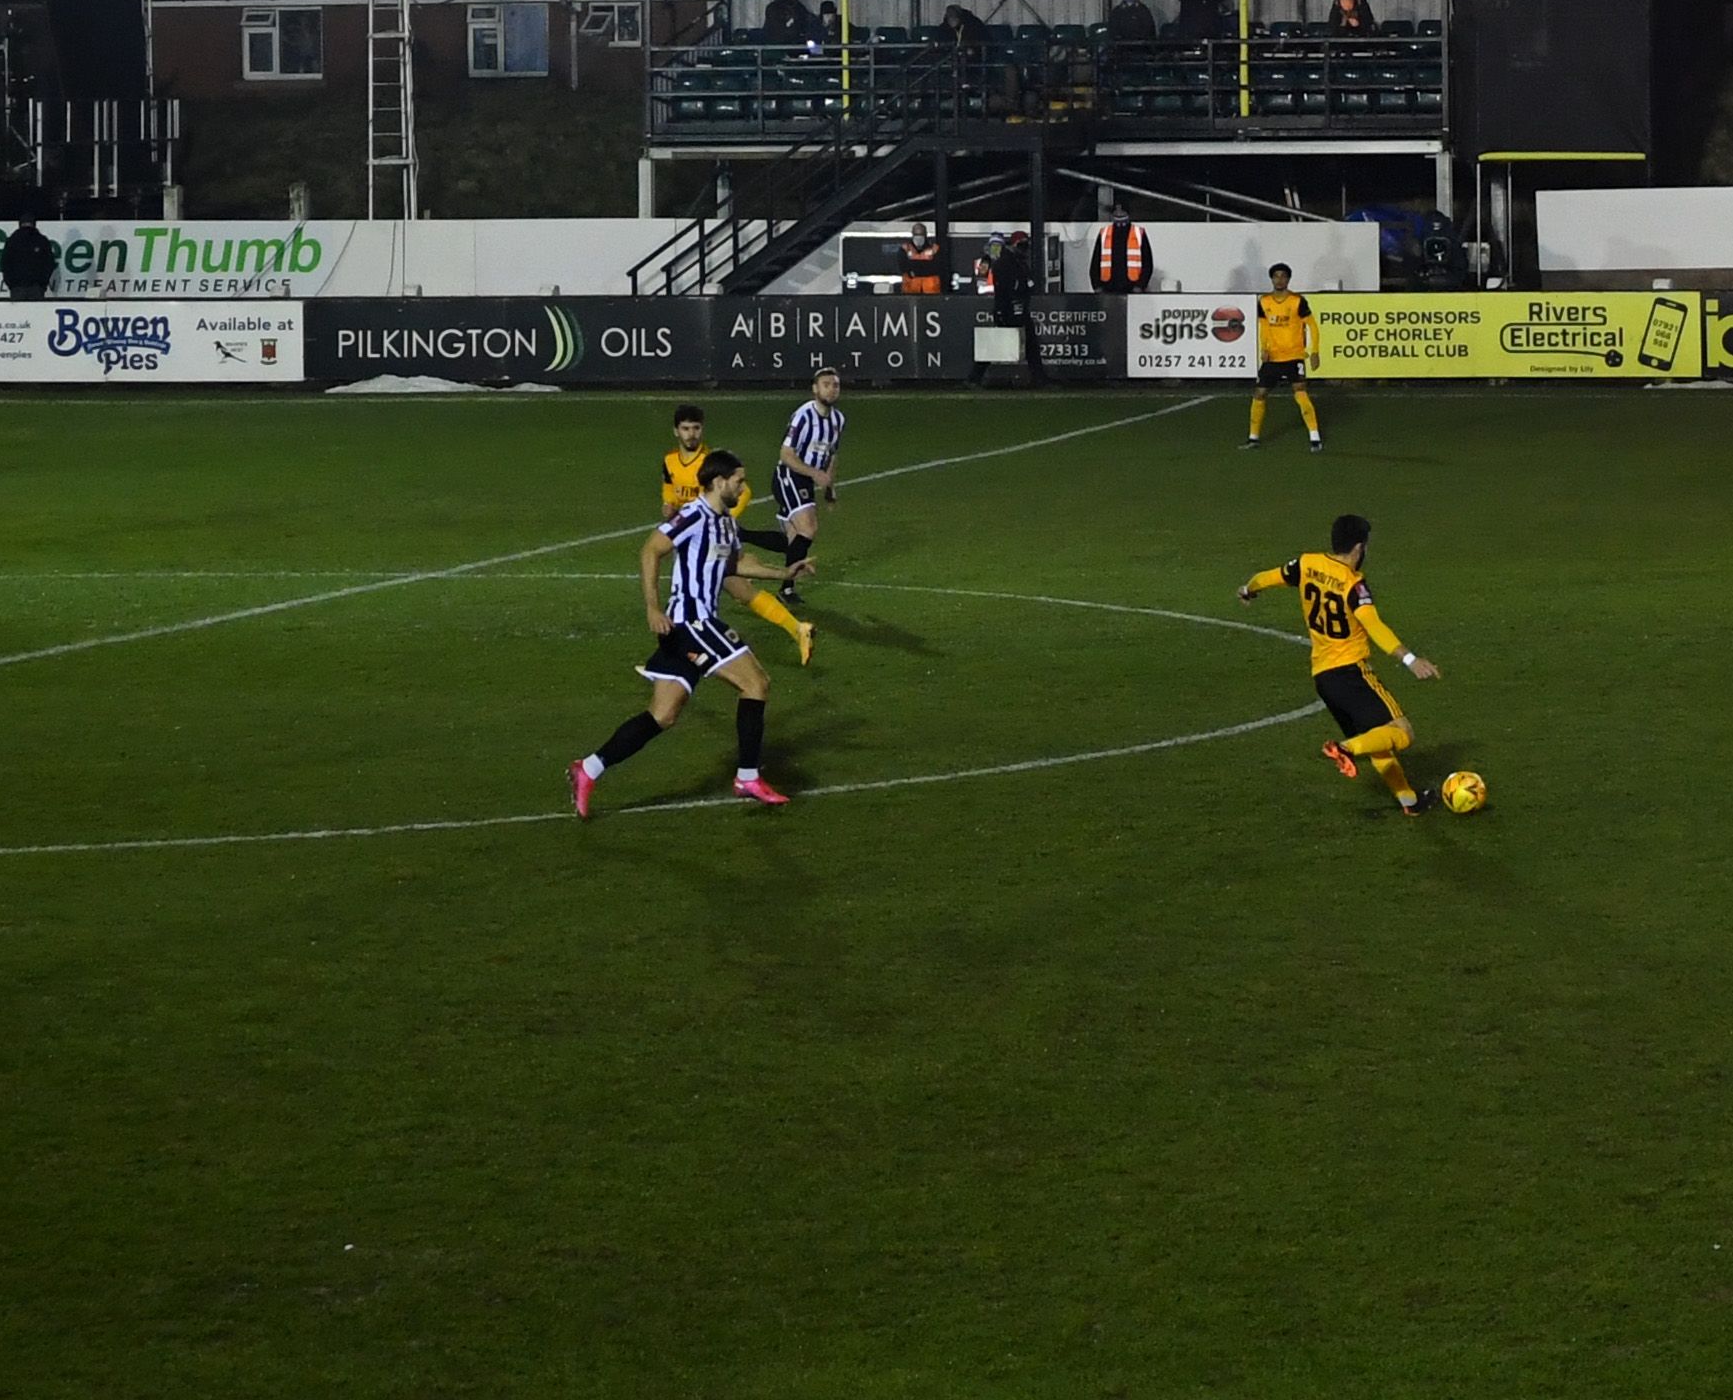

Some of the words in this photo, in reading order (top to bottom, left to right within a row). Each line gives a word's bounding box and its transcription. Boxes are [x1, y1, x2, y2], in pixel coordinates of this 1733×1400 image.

[0, 279, 56, 293] LN
[65, 279, 192, 293] TREATMENT
[1048, 310, 1107, 322] CERTIFIED
[1161, 308, 1209, 328] poppy
[1320, 312, 1379, 326] PROUD
[1385, 311, 1481, 326] SPONSORS
[1528, 302, 1608, 324] Rivers
[196, 317, 271, 332] Available
[277, 318, 294, 332] at
[1034, 324, 1087, 336] UNTANTS
[1140, 319, 1209, 345] signs
[0, 332, 24, 343] 427
[48, 309, 170, 357] Bowen
[1345, 328, 1371, 342] OF
[1374, 327, 1455, 342] CHORLEY
[1510, 327, 1624, 348] Electrical
[337, 328, 537, 359] PILKINGTON
[600, 327, 672, 358] OILS
[1039, 344, 1089, 356] 273313
[730, 351, 942, 368] ASHTON
[1332, 345, 1419, 359] FOOTBALL
[1424, 345, 1469, 358] CLUB
[97, 346, 158, 375] Pies
[1138, 356, 1184, 368] 01257
[1187, 356, 1214, 368] 241
[1219, 355, 1247, 368] 222
[1529, 365, 1567, 375] Designed
[1568, 365, 1579, 375] by
[1304, 582, 1351, 641] 28
